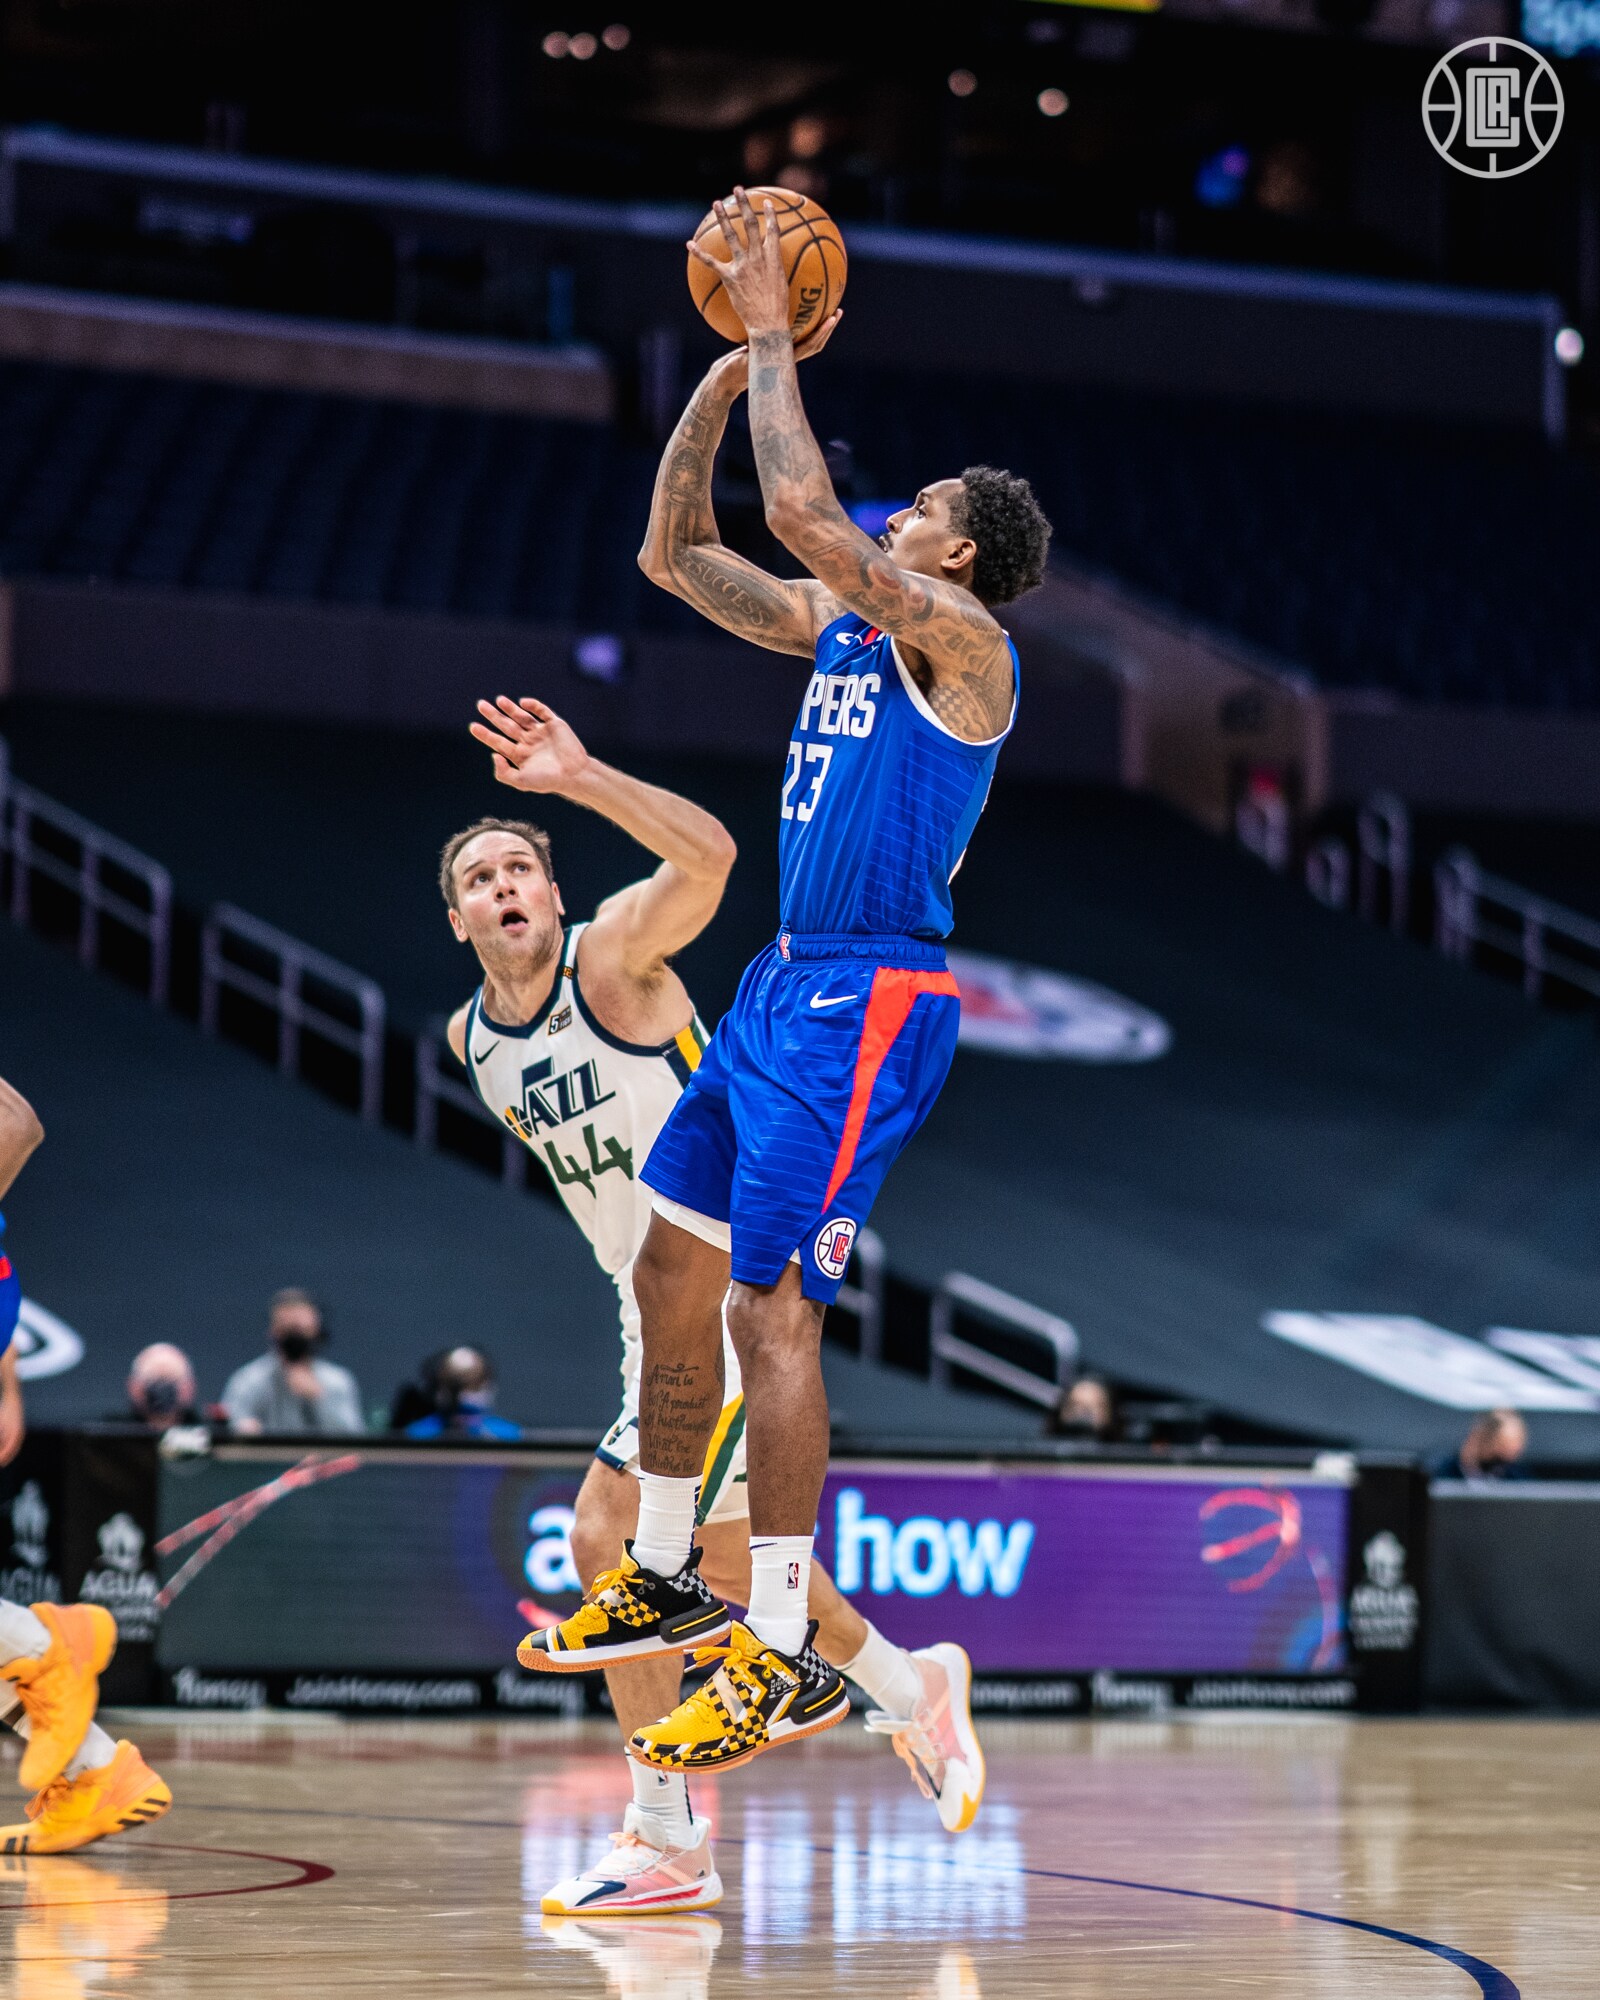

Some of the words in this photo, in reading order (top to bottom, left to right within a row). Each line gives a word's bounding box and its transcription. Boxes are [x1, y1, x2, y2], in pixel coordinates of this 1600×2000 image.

[800, 670, 881, 738] PERS
[781, 741, 834, 822] 23
[506, 1056, 616, 1140] JAZZ
[543, 1123, 634, 1200] 44
[814, 1487, 1035, 1597] how
